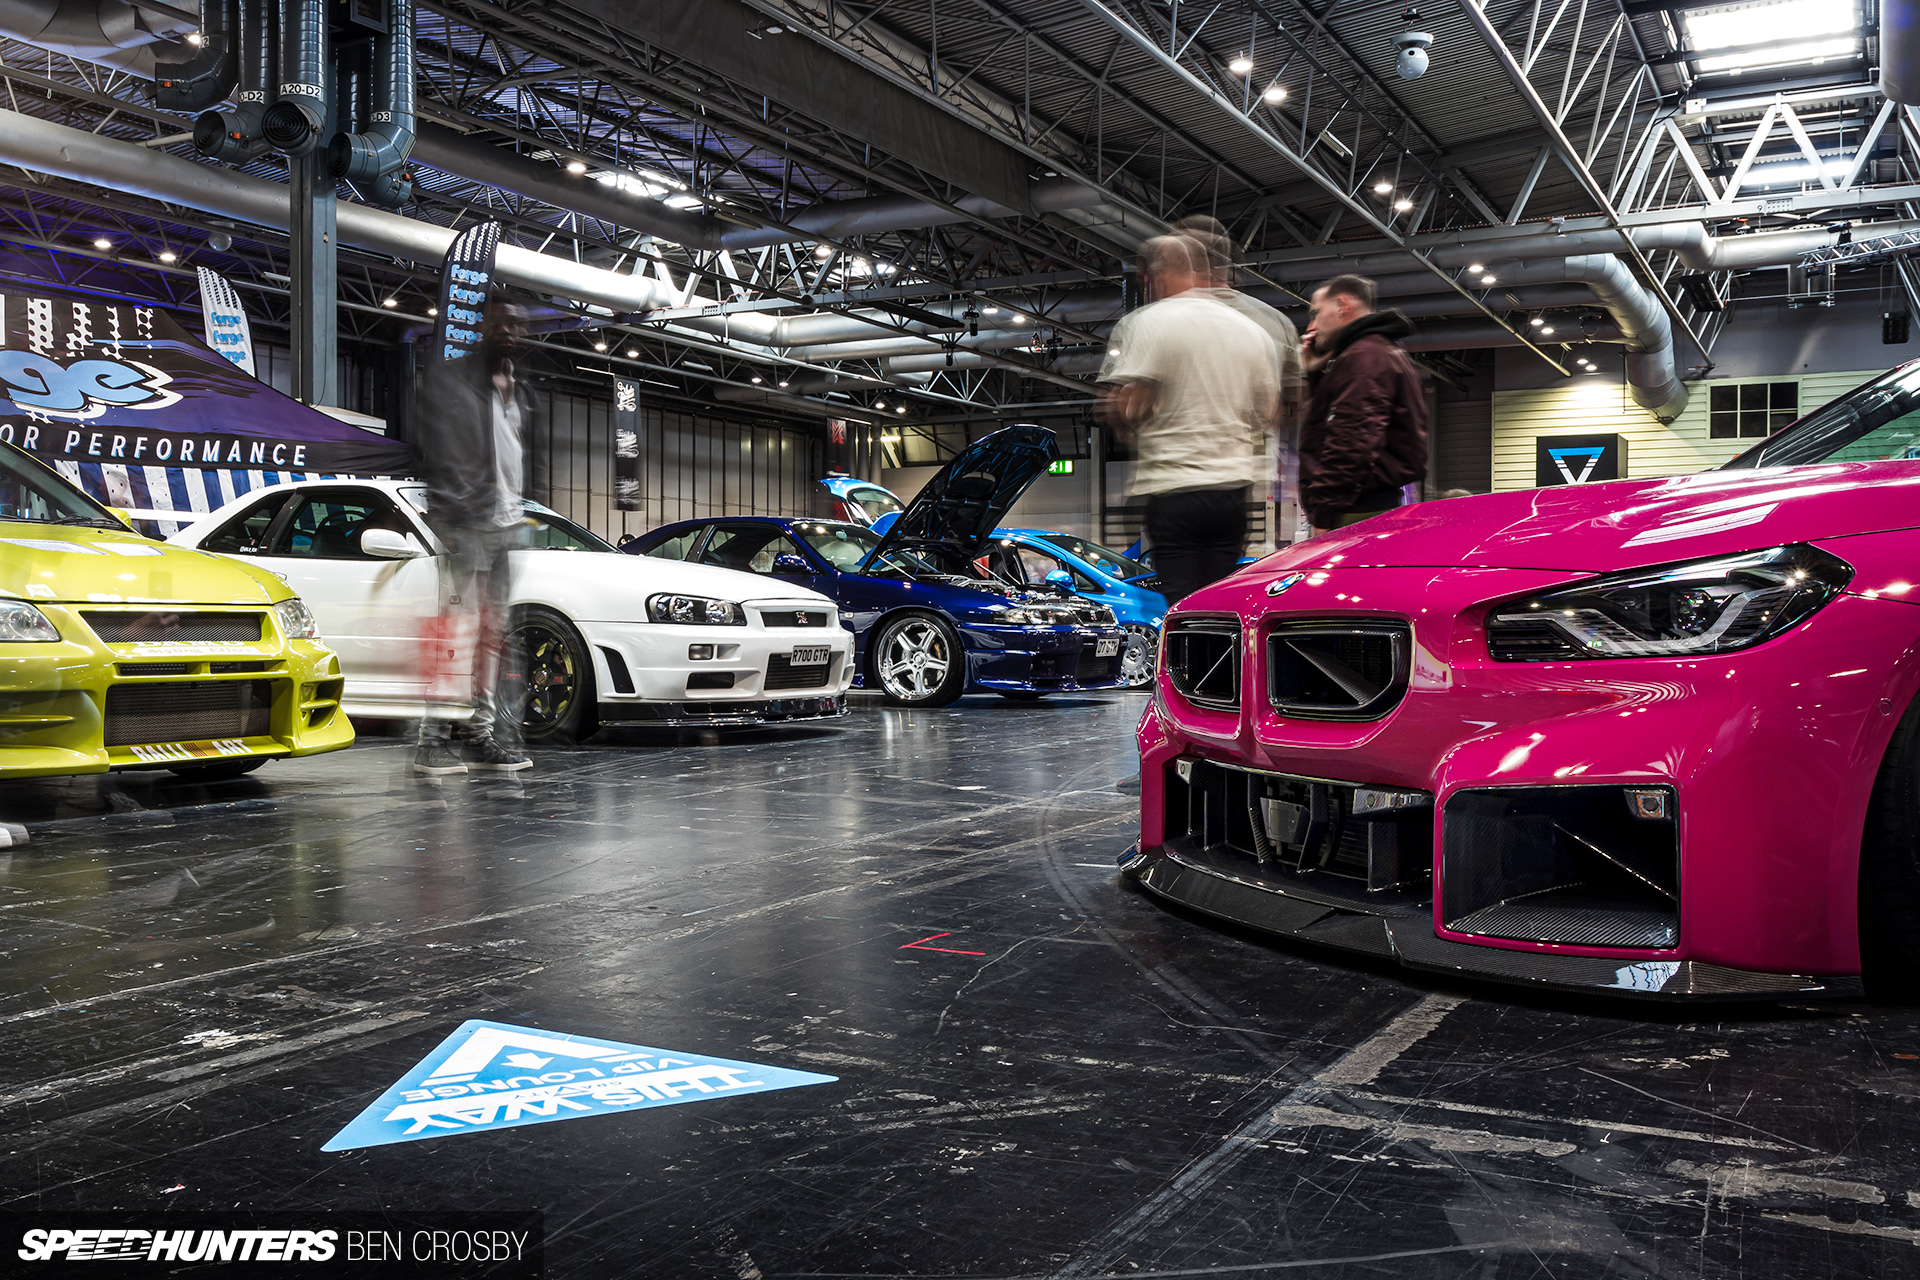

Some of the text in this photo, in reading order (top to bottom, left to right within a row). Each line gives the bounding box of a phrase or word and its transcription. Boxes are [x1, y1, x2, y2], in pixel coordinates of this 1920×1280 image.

[280, 84, 321, 97] A20-D2
[215, 348, 246, 363] orge
[64, 430, 306, 466] PERFORMANCE
[792, 649, 828, 662] R700 GTR
[130, 739, 253, 761] RALLI ART
[399, 1057, 694, 1102] VIP LOUNGE
[402, 1072, 765, 1135] THIS WAY
